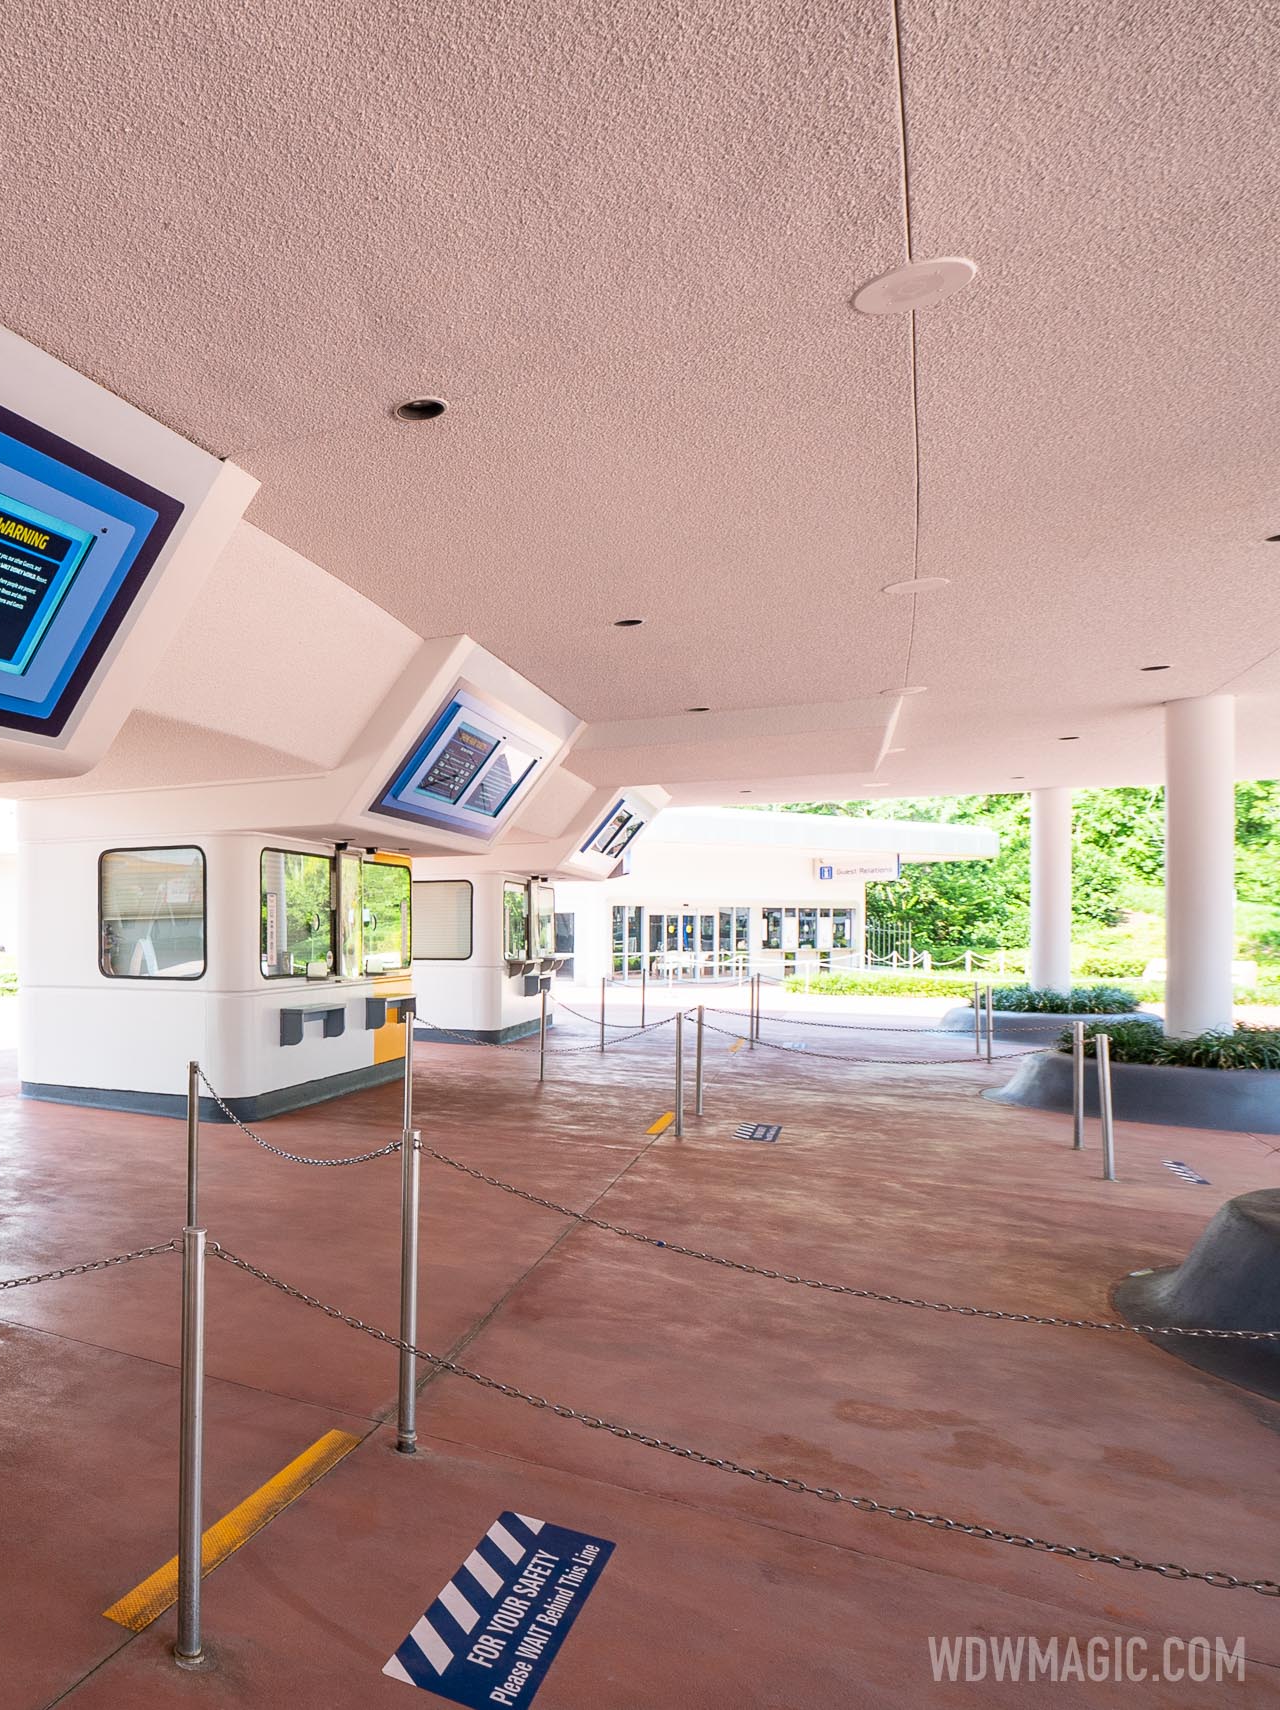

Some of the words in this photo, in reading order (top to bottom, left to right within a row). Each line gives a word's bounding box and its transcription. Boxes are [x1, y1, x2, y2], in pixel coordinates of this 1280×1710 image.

[513, 1549, 560, 1598] SAFETY
[572, 1544, 600, 1567] Line
[558, 1565, 588, 1588] This
[486, 1595, 531, 1636] YOUR
[535, 1585, 575, 1627] Behind
[466, 1635, 507, 1669] FOR
[515, 1623, 552, 1660] WAIT
[489, 1660, 533, 1707] Please
